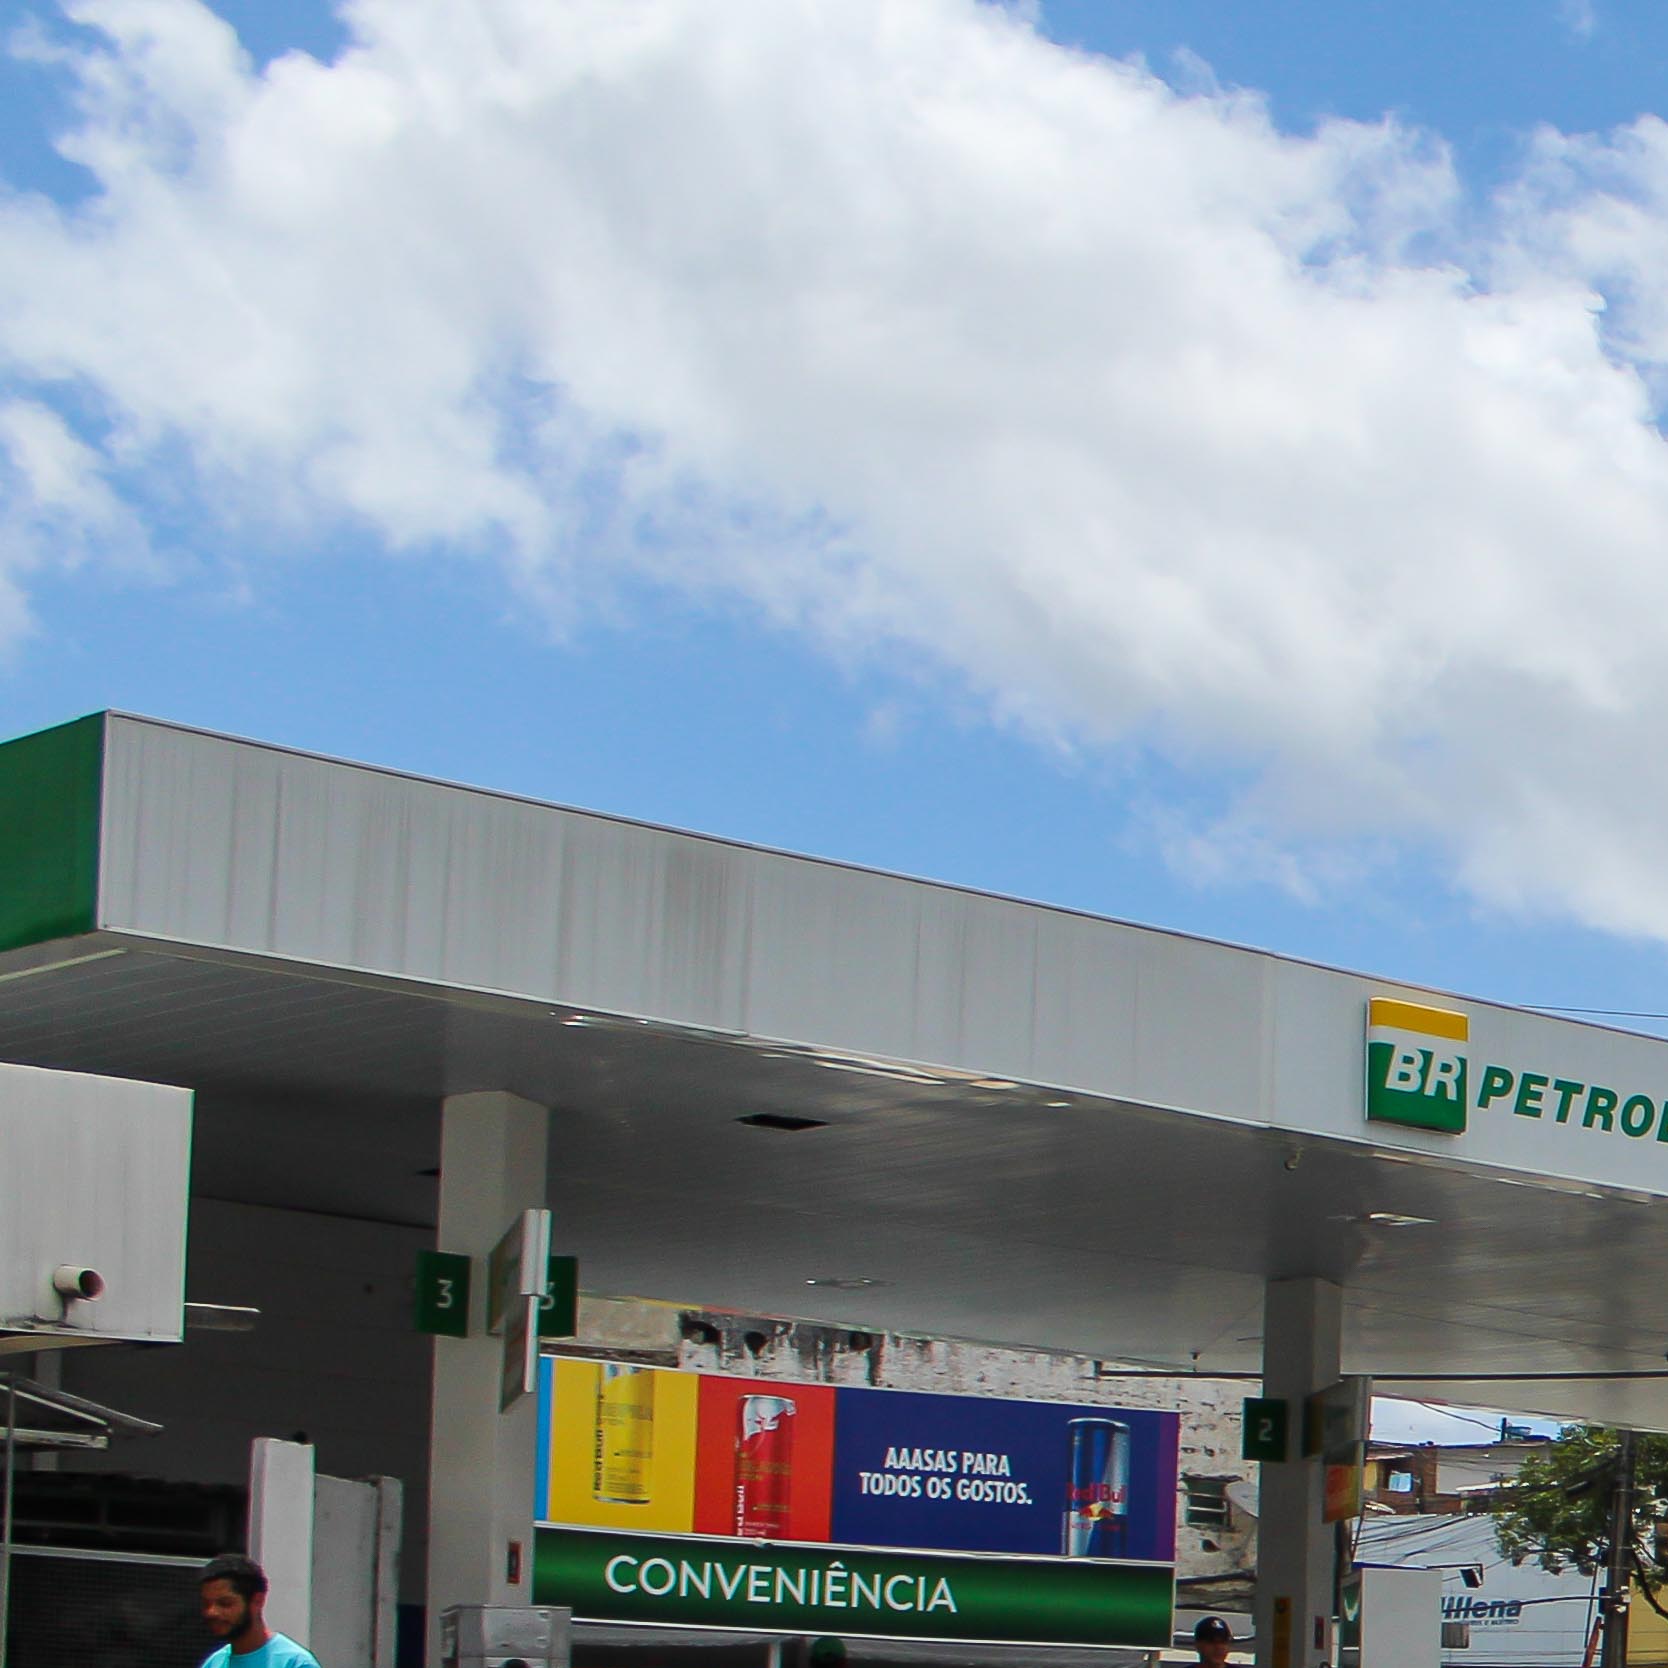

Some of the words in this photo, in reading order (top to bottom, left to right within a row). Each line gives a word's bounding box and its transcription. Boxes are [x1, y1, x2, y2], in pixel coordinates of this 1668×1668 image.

[1385, 1046, 1462, 1100] BR
[437, 1279, 452, 1308] 3
[1259, 1418, 1272, 1442] 2
[884, 1447, 957, 1473] AAASAS
[961, 1452, 1011, 1477] PARA
[859, 1472, 922, 1498] TODOS
[926, 1477, 952, 1499] OS
[956, 1479, 1033, 1505] GOSTOS.
[605, 1555, 957, 1613] CONVENIÊNCIA
